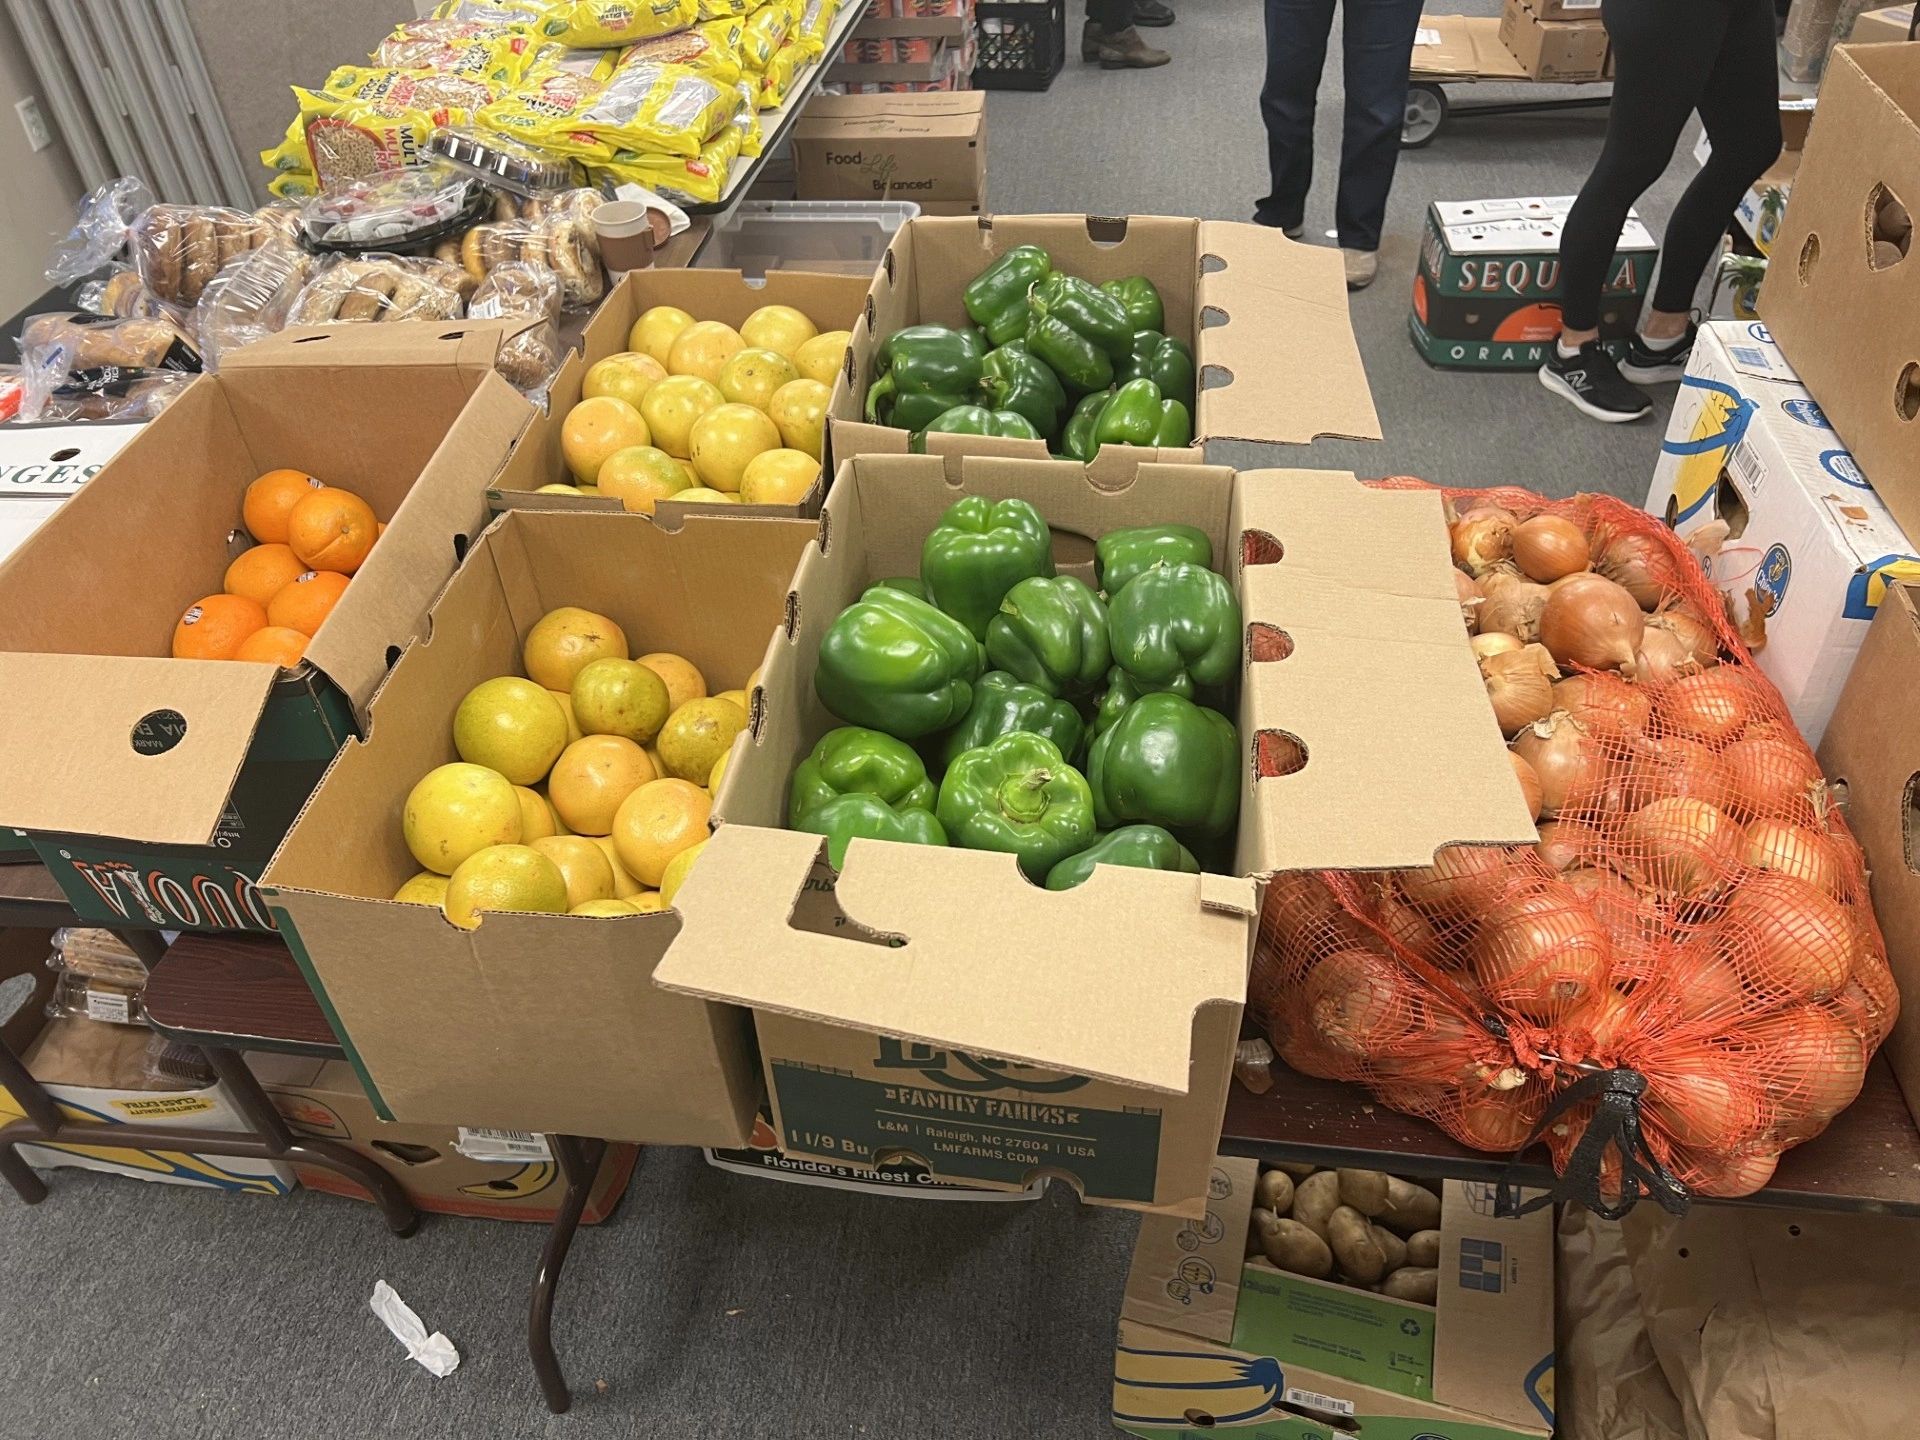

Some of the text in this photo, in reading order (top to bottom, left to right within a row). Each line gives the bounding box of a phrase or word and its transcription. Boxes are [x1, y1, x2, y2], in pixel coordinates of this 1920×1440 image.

[826, 151, 862, 165] Food
[873, 178, 933, 191] Baanced
[1458, 256, 1638, 295] SEQUA
[1451, 345, 1615, 361] ORANS
[122, 1096, 197, 1109] CLASS EXTRA
[899, 1088, 1065, 1125] FAMILY FARMS
[841, 1139, 869, 1156] Bu
[877, 1120, 1096, 1158] L&M Raleigh, NC 27604 USA
[934, 1142, 1039, 1165] LMFARMS.COM
[763, 1155, 846, 1176] Florida's
